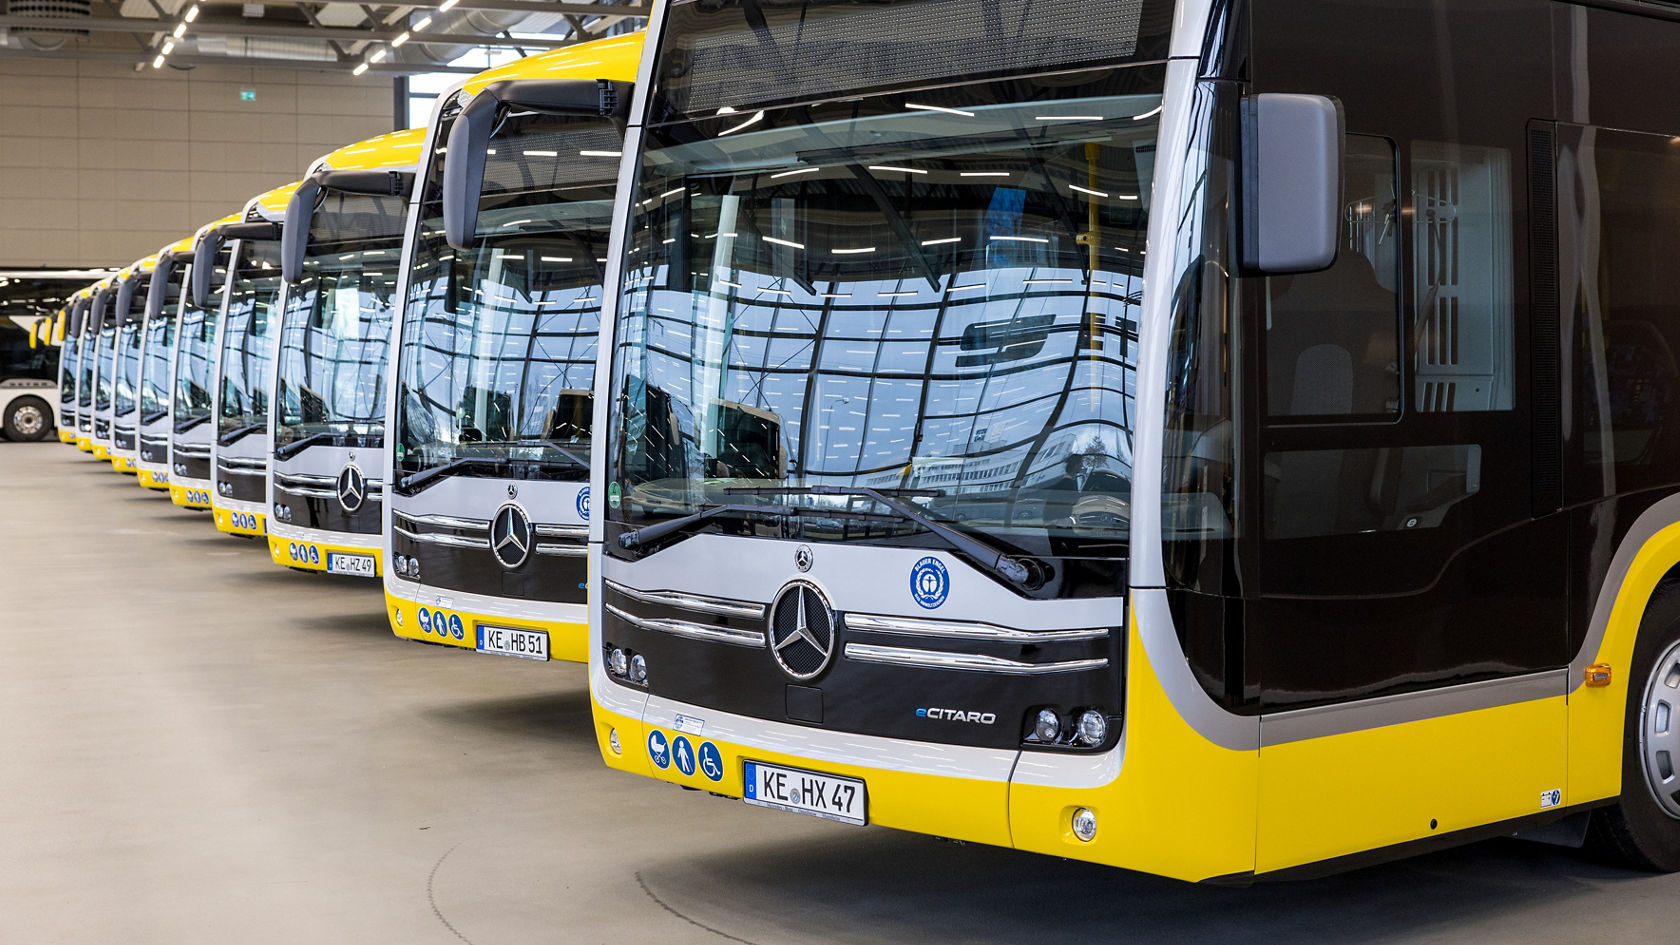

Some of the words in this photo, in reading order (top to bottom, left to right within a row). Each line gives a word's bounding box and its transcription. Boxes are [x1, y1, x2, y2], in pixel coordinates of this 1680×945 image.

[335, 556, 345, 570] KE
[350, 558, 361, 571] HZ
[362, 559, 372, 572] 49
[488, 630, 504, 649] KE
[511, 633, 526, 652] HB
[528, 635, 543, 654] 51
[915, 707, 997, 725] eCITARO
[763, 770, 789, 801] KE
[801, 776, 827, 809] HX
[832, 783, 856, 813] 47
